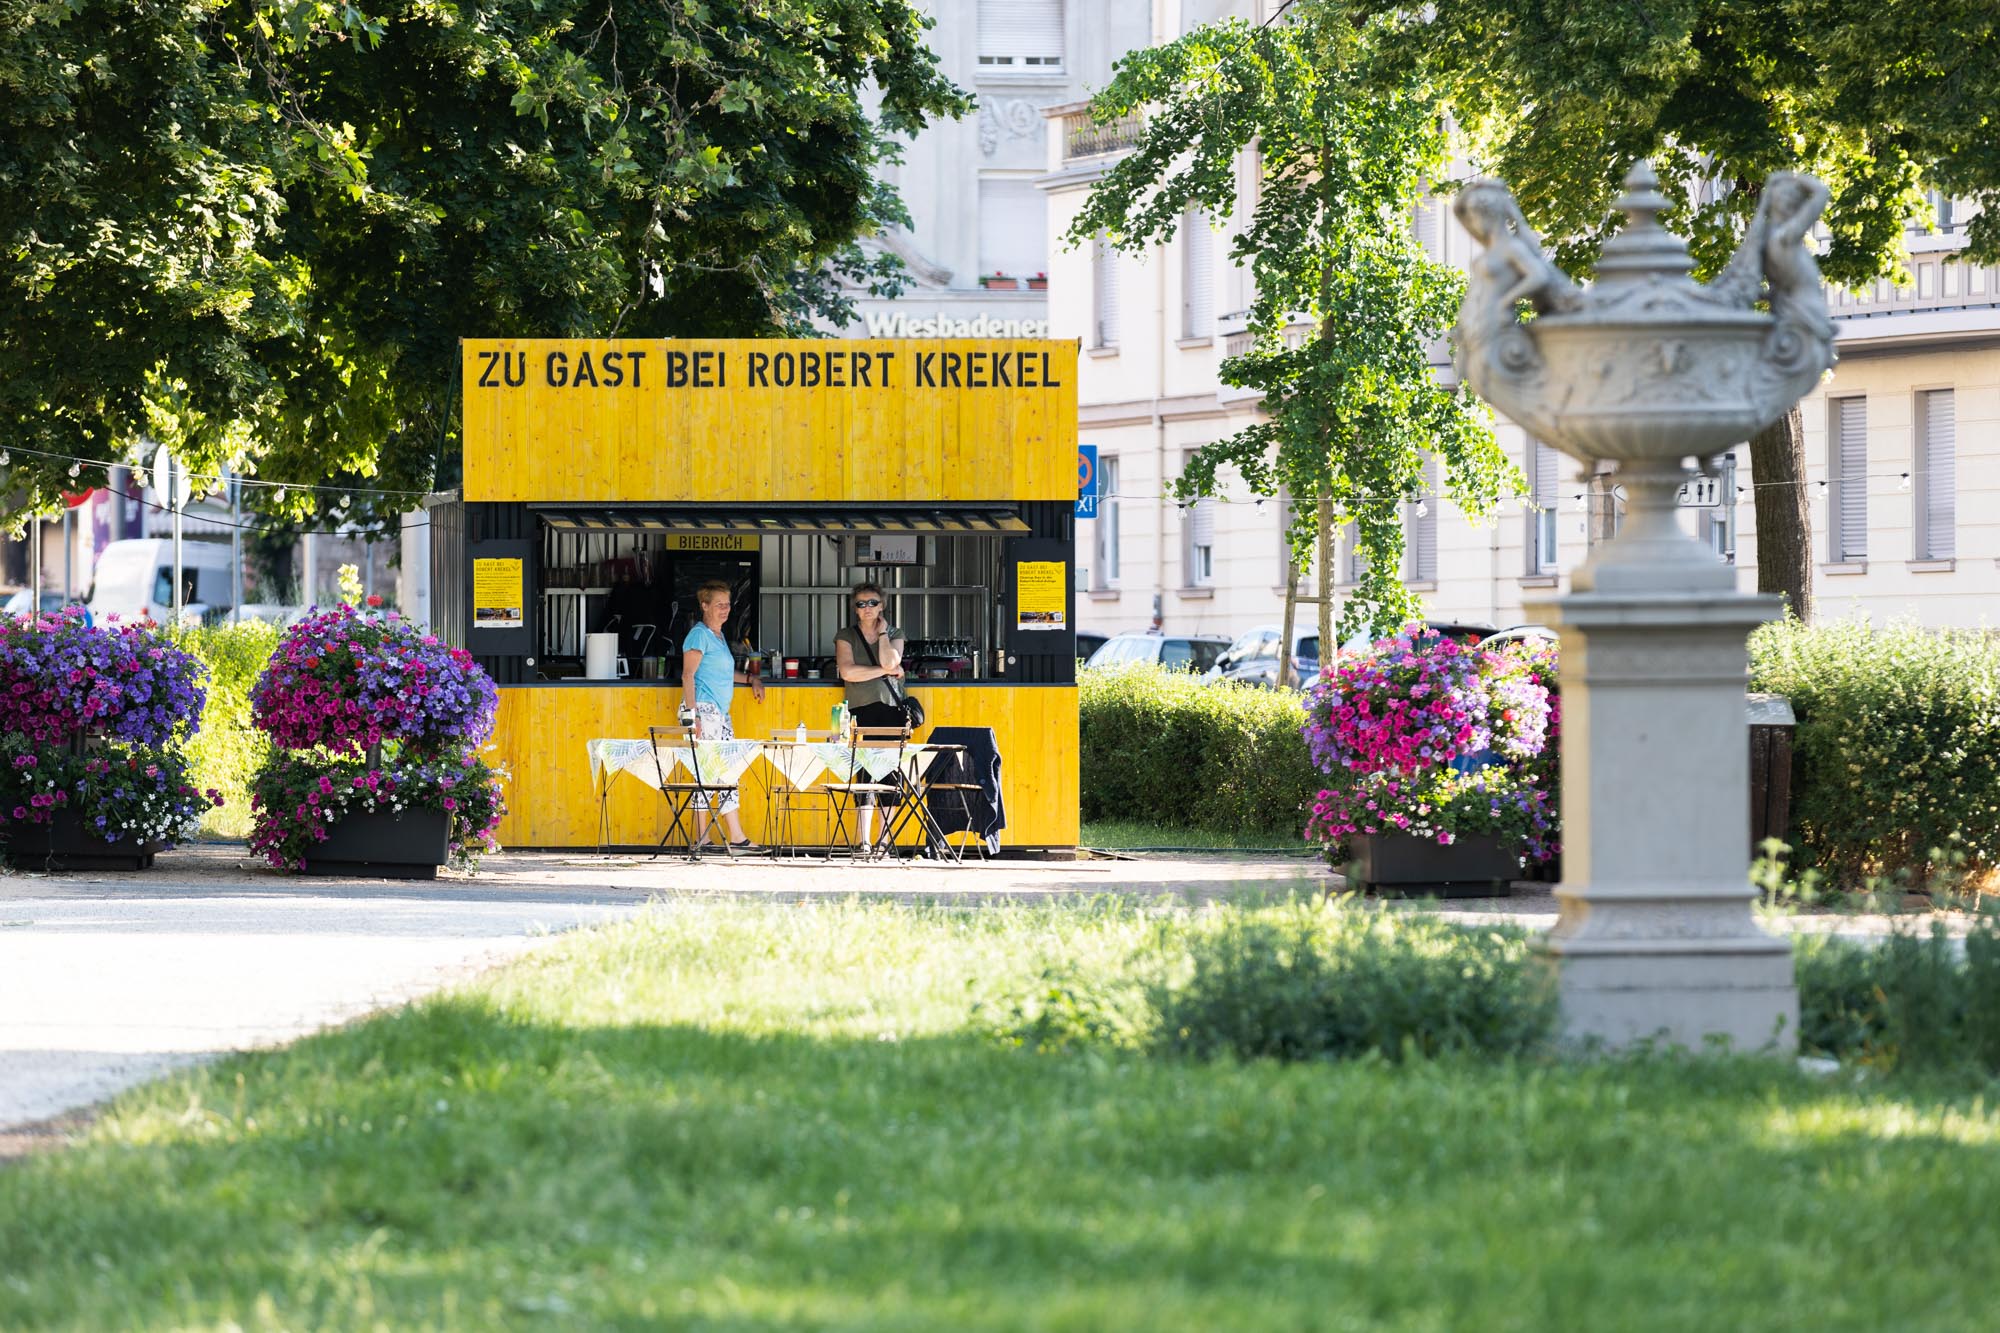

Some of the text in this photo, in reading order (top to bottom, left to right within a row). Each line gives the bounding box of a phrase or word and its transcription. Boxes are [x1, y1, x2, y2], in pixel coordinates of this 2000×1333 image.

[865, 312, 1048, 338] Wiesbadener
[479, 352, 1060, 387] ZU GAST BEI ROBERT KREKEL
[679, 535, 743, 549] BIEBRICH
